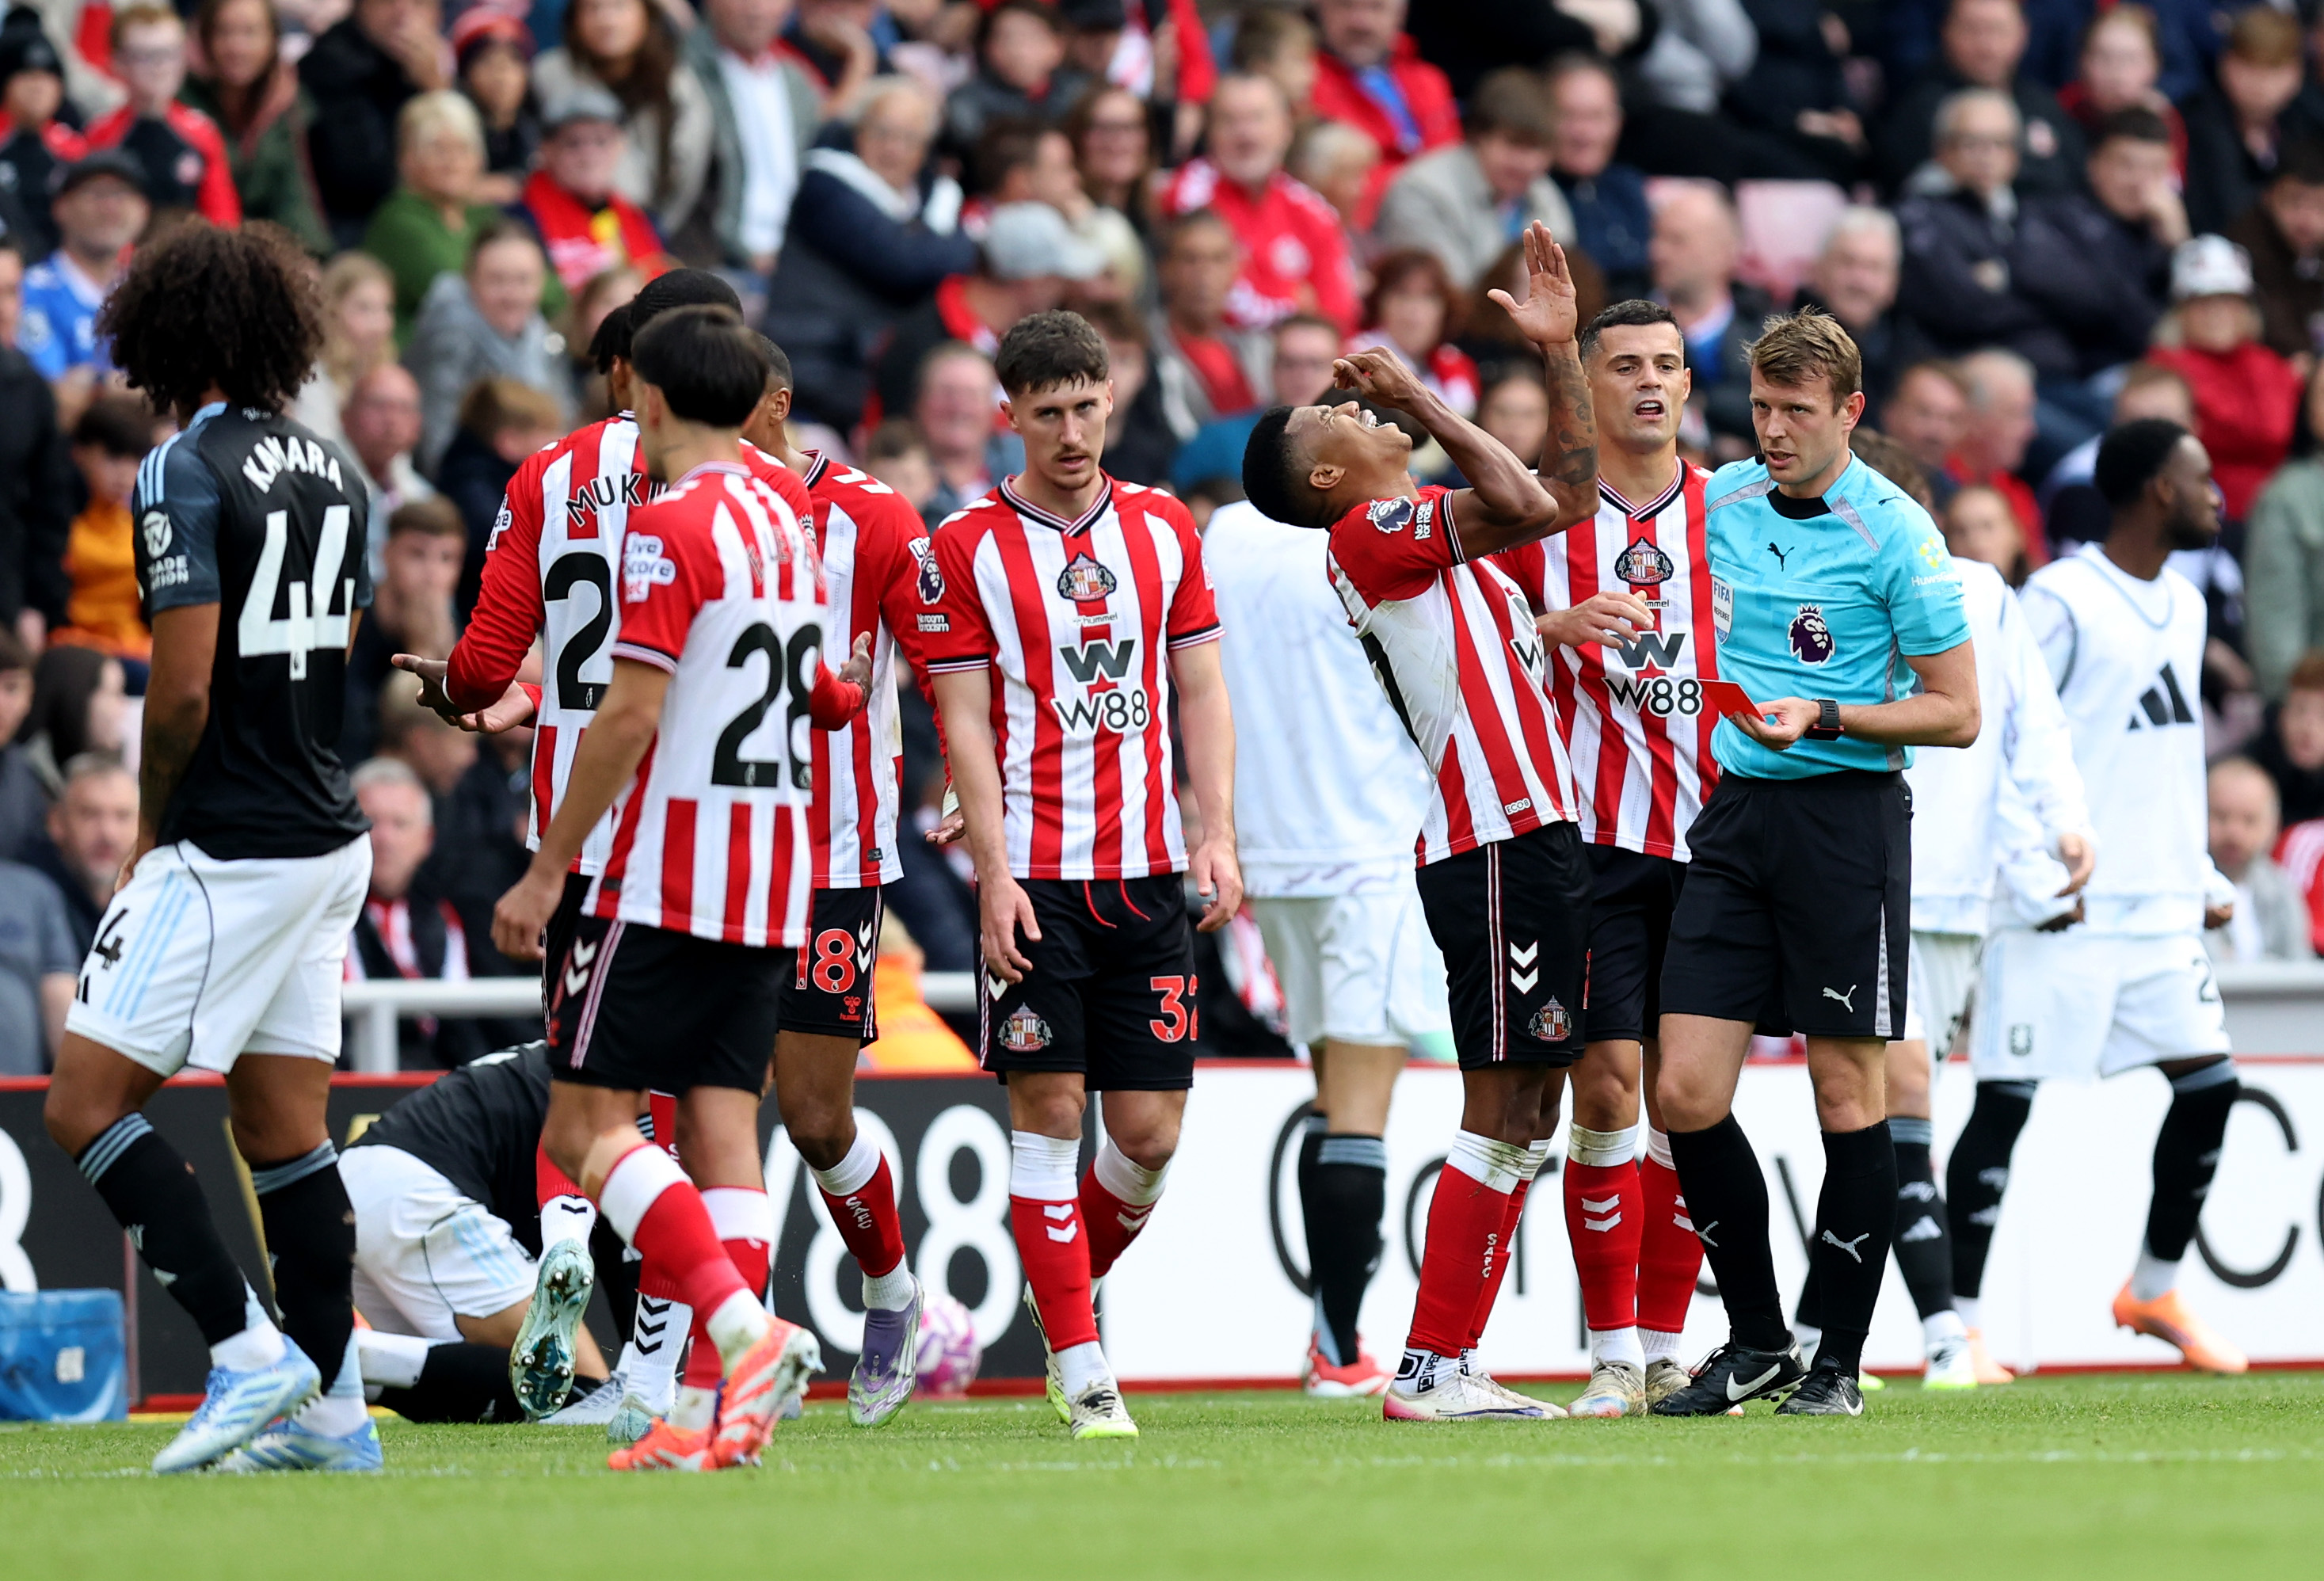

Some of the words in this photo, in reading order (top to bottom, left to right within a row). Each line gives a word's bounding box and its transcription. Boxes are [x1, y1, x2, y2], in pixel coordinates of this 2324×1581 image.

[566, 473, 669, 528] MUKI
[238, 504, 356, 682] 44
[1645, 599, 1670, 608] mmel
[1713, 581, 1731, 604] FIFA
[1083, 611, 1118, 624] hummel
[1713, 605, 1730, 623] REFEREE
[1059, 638, 1136, 684] W
[1054, 689, 1148, 733] W88
[1604, 678, 1701, 715] W88
[1506, 798, 1530, 814] ECO8
[795, 927, 856, 994] 18
[1481, 1232, 1498, 1278] SAFC
